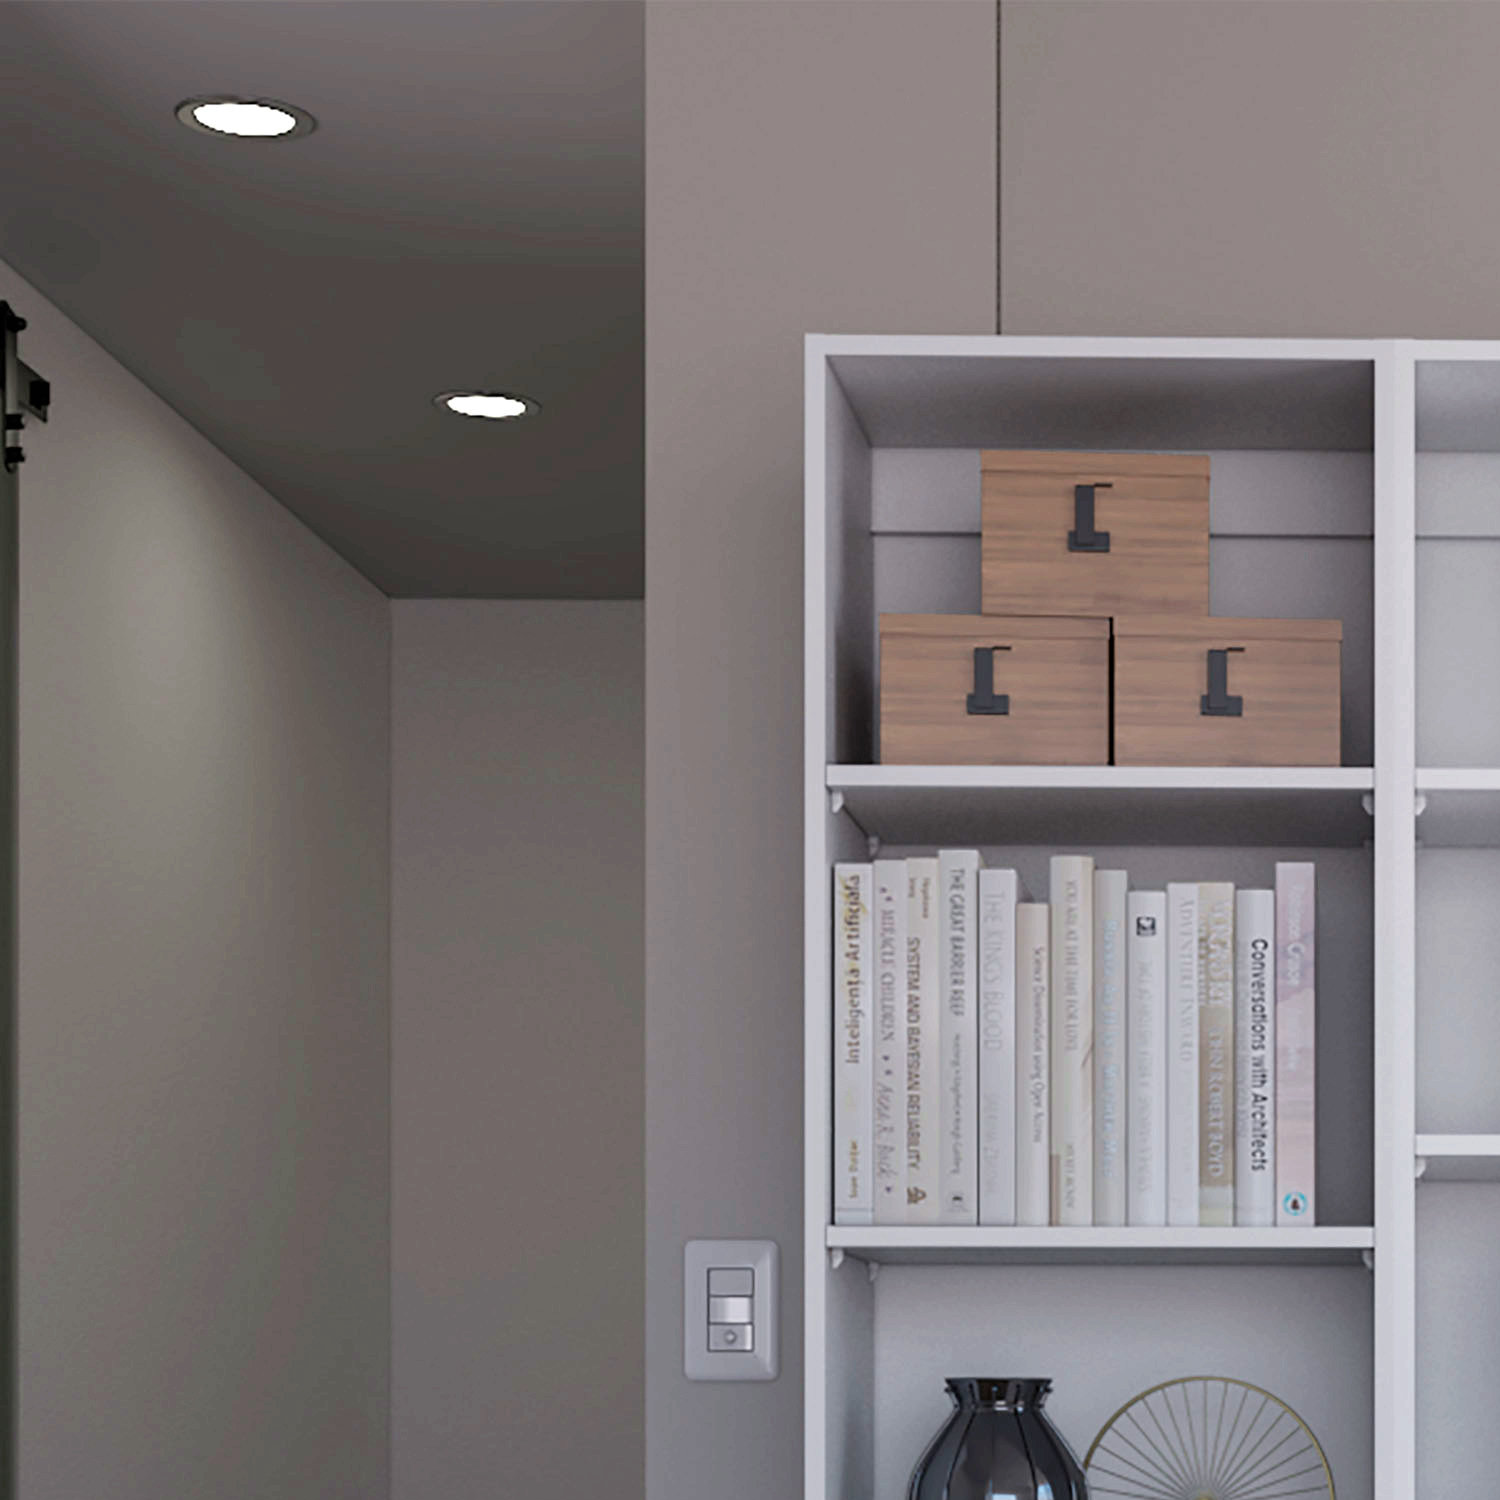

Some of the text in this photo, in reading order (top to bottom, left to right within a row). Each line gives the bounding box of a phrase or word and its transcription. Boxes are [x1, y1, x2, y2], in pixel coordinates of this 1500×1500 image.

[950, 869, 965, 1016] THE GREAT BARRIER REEF
[1034, 947, 1045, 982] Science
[907, 938, 920, 1169] SYSTEM AND BAYESIAN RELIABILITY
[1251, 939, 1267, 1171] Conversations with Architects
